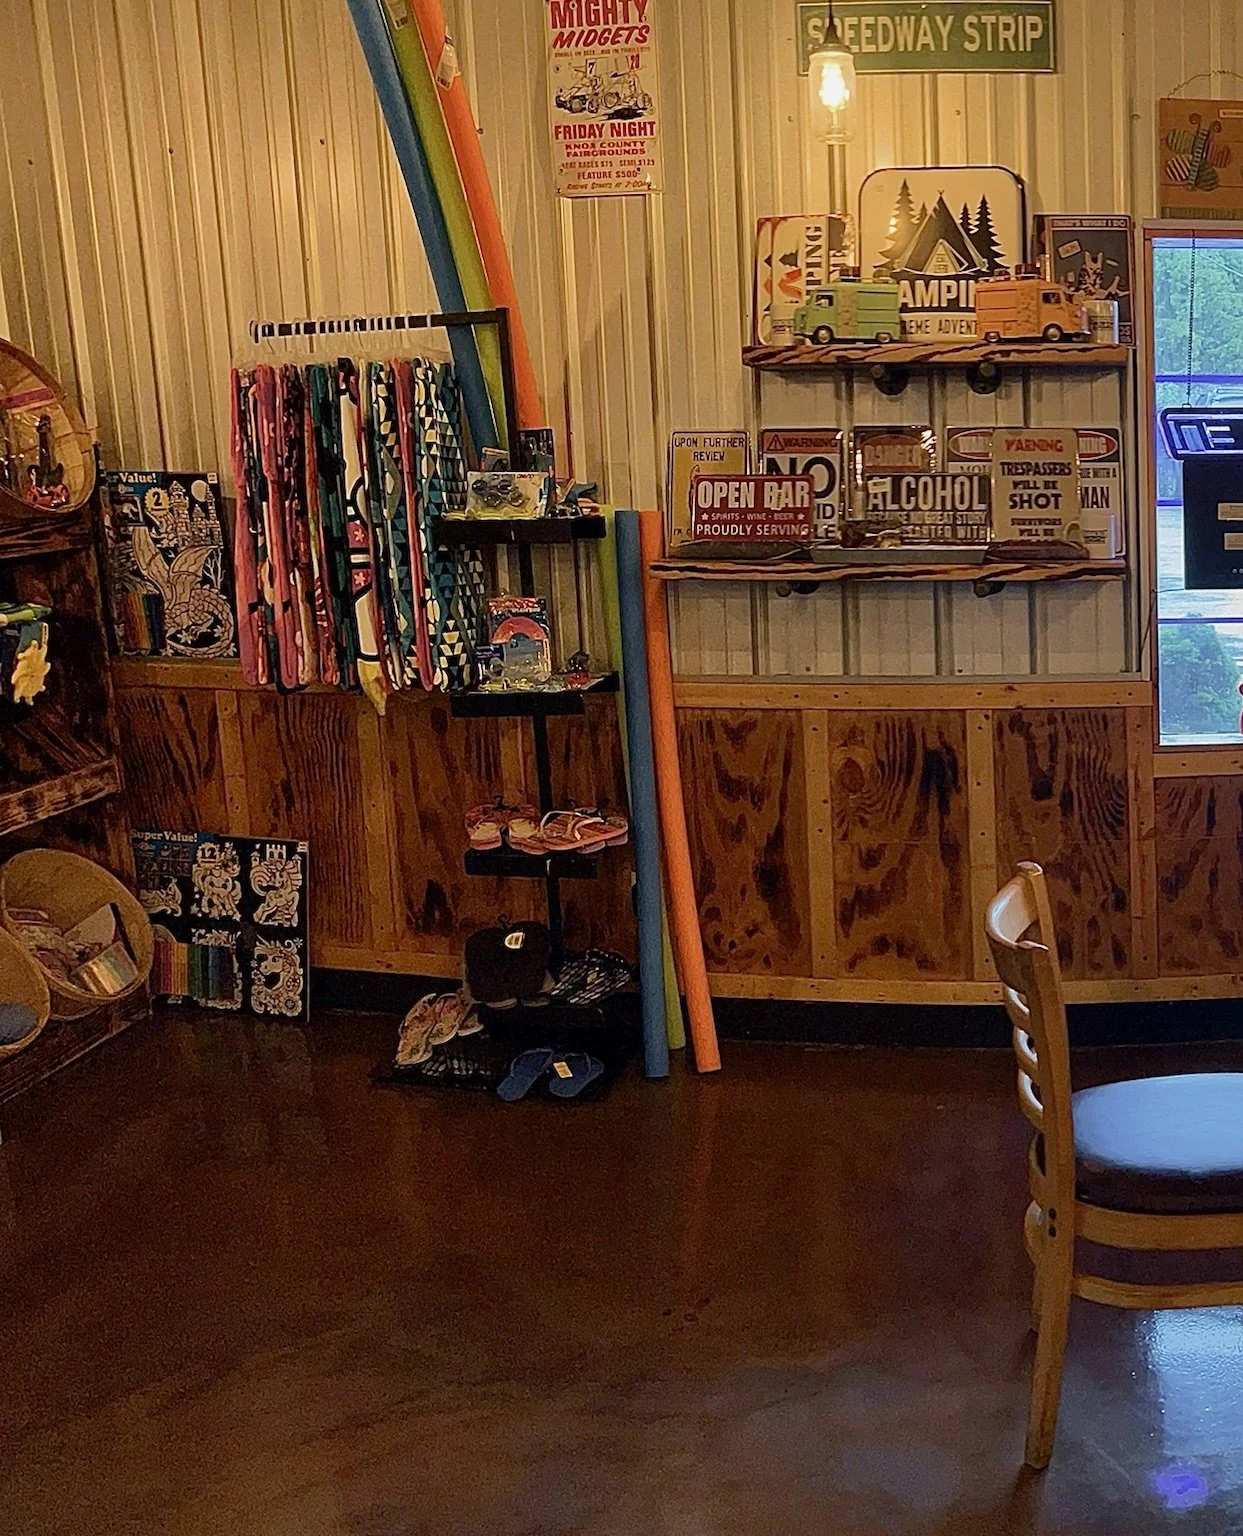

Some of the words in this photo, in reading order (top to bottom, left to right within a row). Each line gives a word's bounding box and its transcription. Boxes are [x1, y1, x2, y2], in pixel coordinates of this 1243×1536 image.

[551, 0, 648, 28] MIGHTY
[553, 25, 650, 49] MIDGETS
[963, 15, 1043, 52] STRIP
[554, 123, 605, 140] FRIDAY
[609, 121, 656, 137] NIGHT
[599, 141, 646, 149] COUNTY
[566, 148, 646, 158] FAIRGROUNDS
[577, 170, 613, 180] FEATURE
[615, 170, 640, 178] $500
[674, 437, 698, 448] UPON
[703, 437, 745, 448] FURTHER
[783, 438, 838, 448] WARNING
[1005, 438, 1064, 452] WARNING
[693, 451, 726, 462] REVIEW
[1001, 462, 1072, 477] TRESPASSERS
[119, 472, 157, 483] Value!
[151, 491, 163, 507] 2
[697, 480, 755, 509] OPEN
[764, 481, 810, 510] BAR
[867, 475, 987, 511] ALCOHOL
[1009, 494, 1063, 510] SHOT
[711, 512, 740, 521] SPIRITS
[746, 512, 767, 521] WINE
[773, 512, 795, 521] BEER
[955, 511, 988, 525] STORY
[696, 524, 751, 536] PROUDLY
[756, 523, 810, 536] SERVING
[130, 829, 164, 841] Super
[163, 831, 198, 843] Value!
